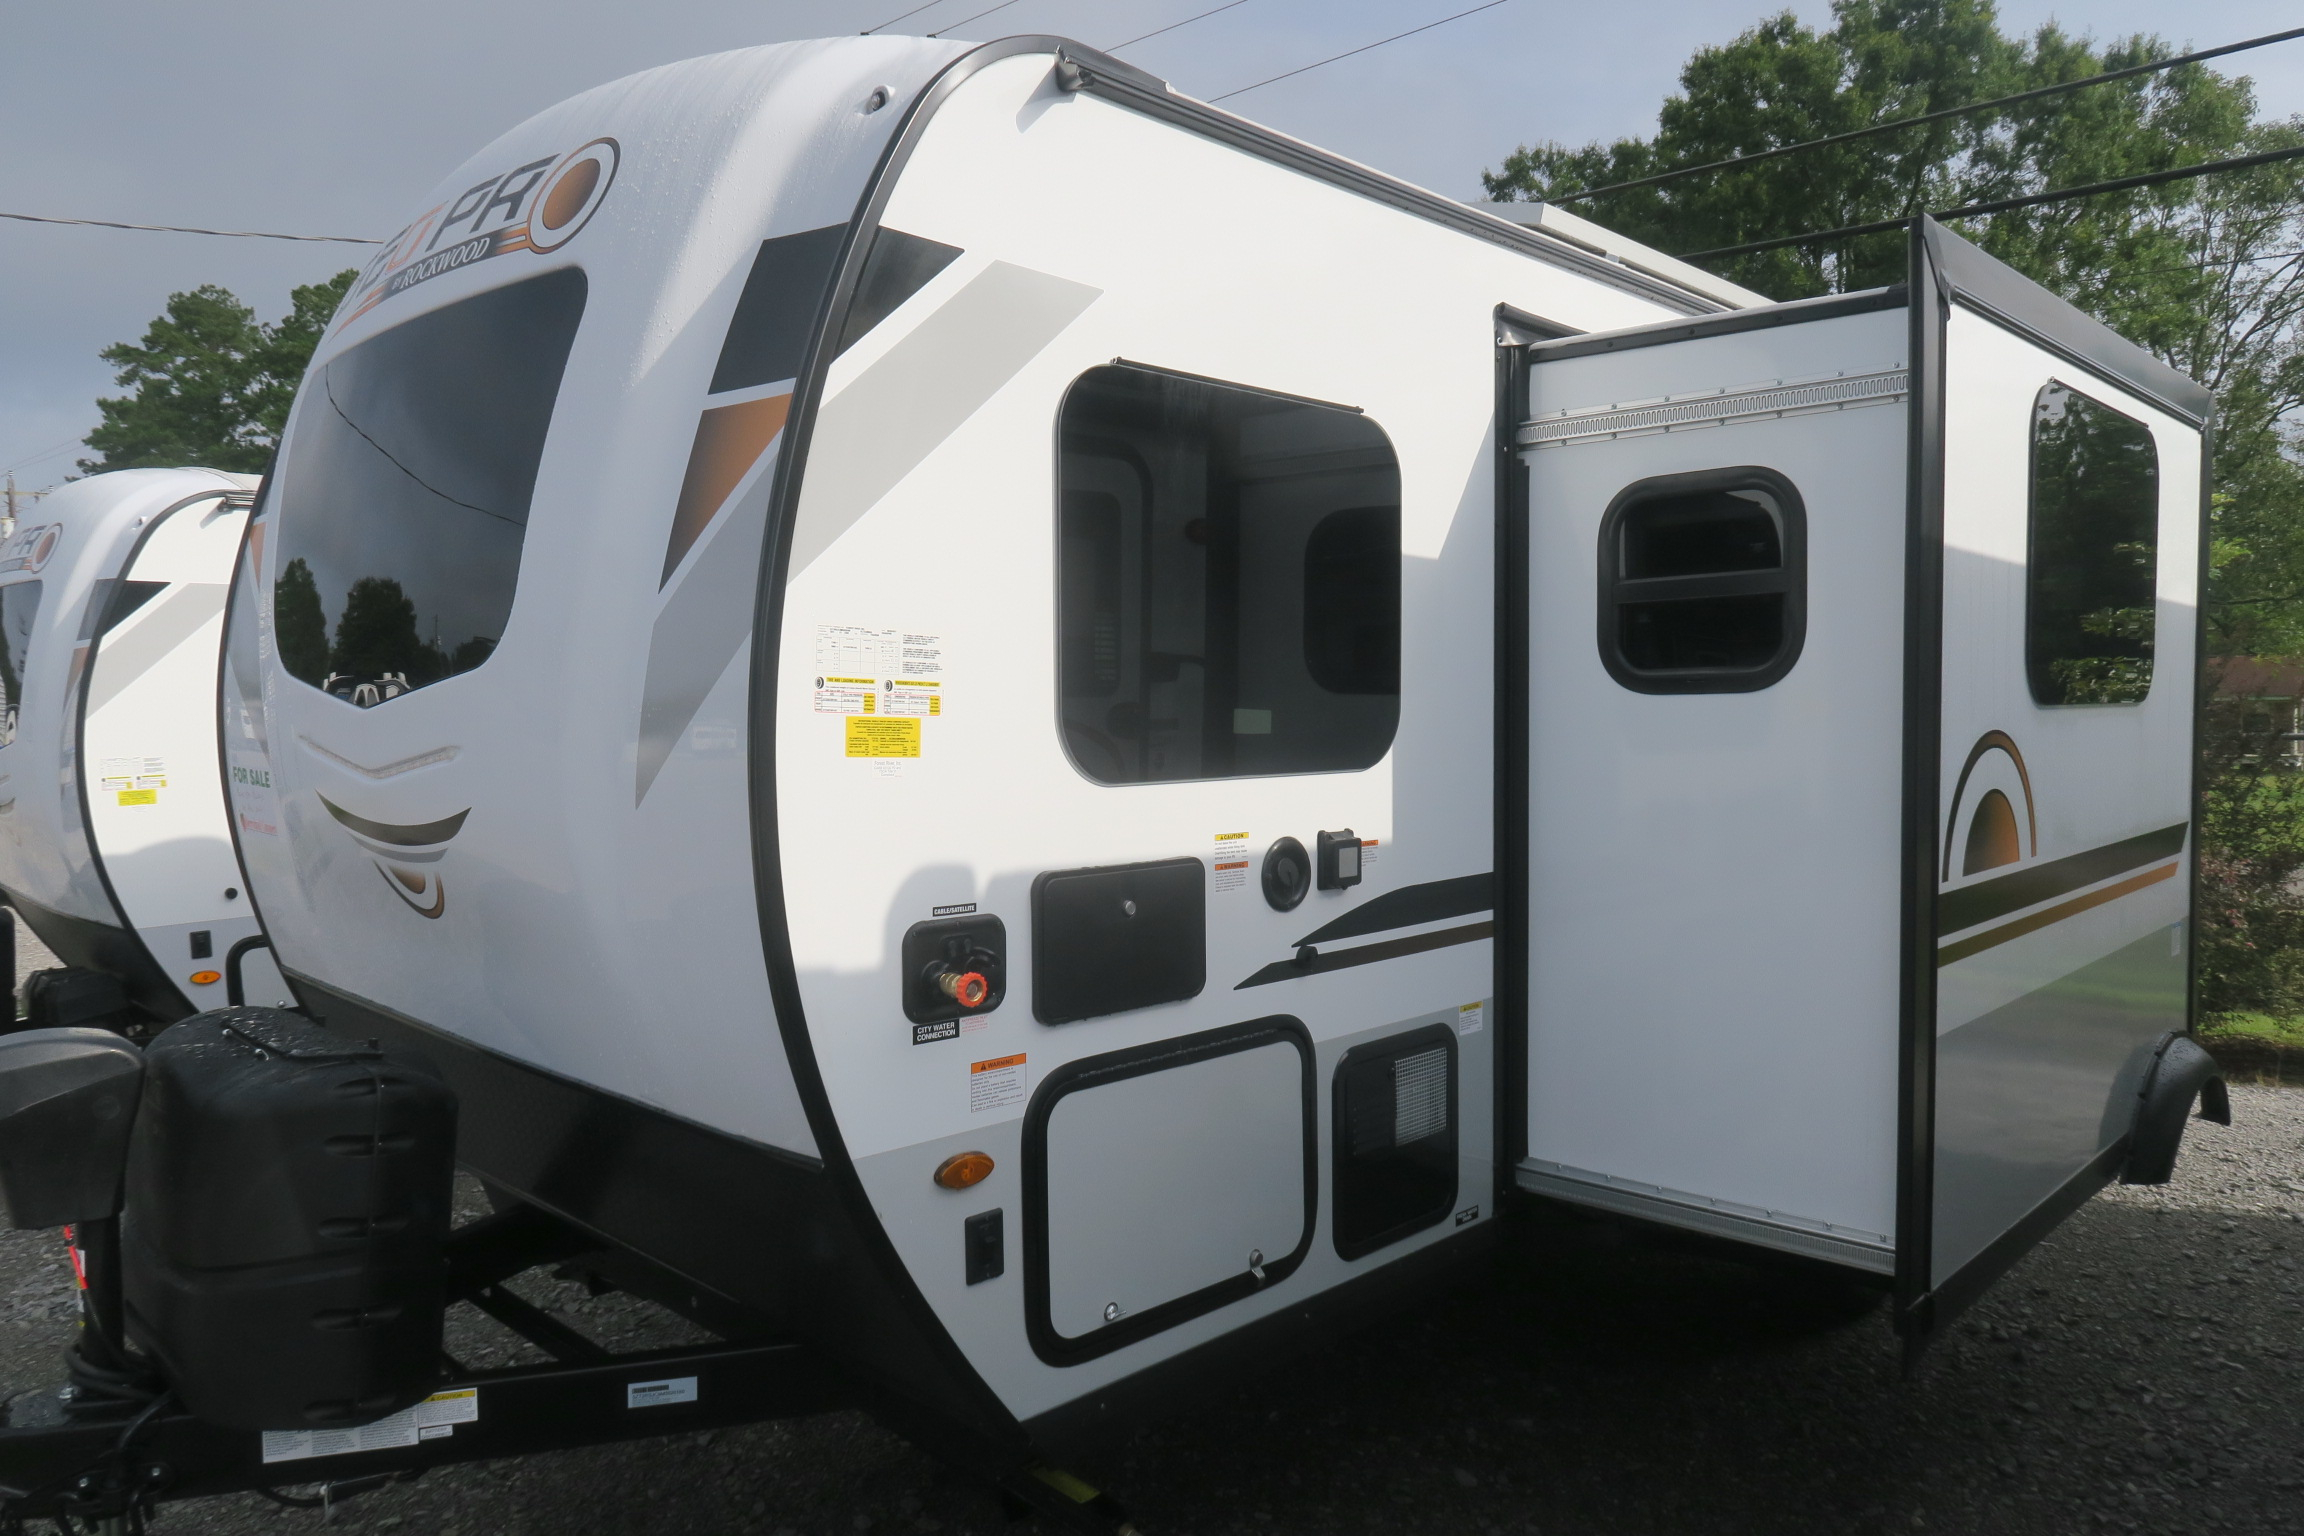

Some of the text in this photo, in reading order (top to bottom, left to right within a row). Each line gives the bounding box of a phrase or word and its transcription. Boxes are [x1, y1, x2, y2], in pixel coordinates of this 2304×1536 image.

[399, 237, 491, 290] ROCKWOOD
[232, 766, 271, 788] FOR SALE
[1223, 832, 1244, 840] CAUTION
[933, 904, 976, 916] CABLE/SATELLITE
[916, 1028, 956, 1042] CONNECTION
[917, 1025, 932, 1035] CITY
[933, 1021, 955, 1031] WATER
[987, 1058, 1014, 1069] WARNING
